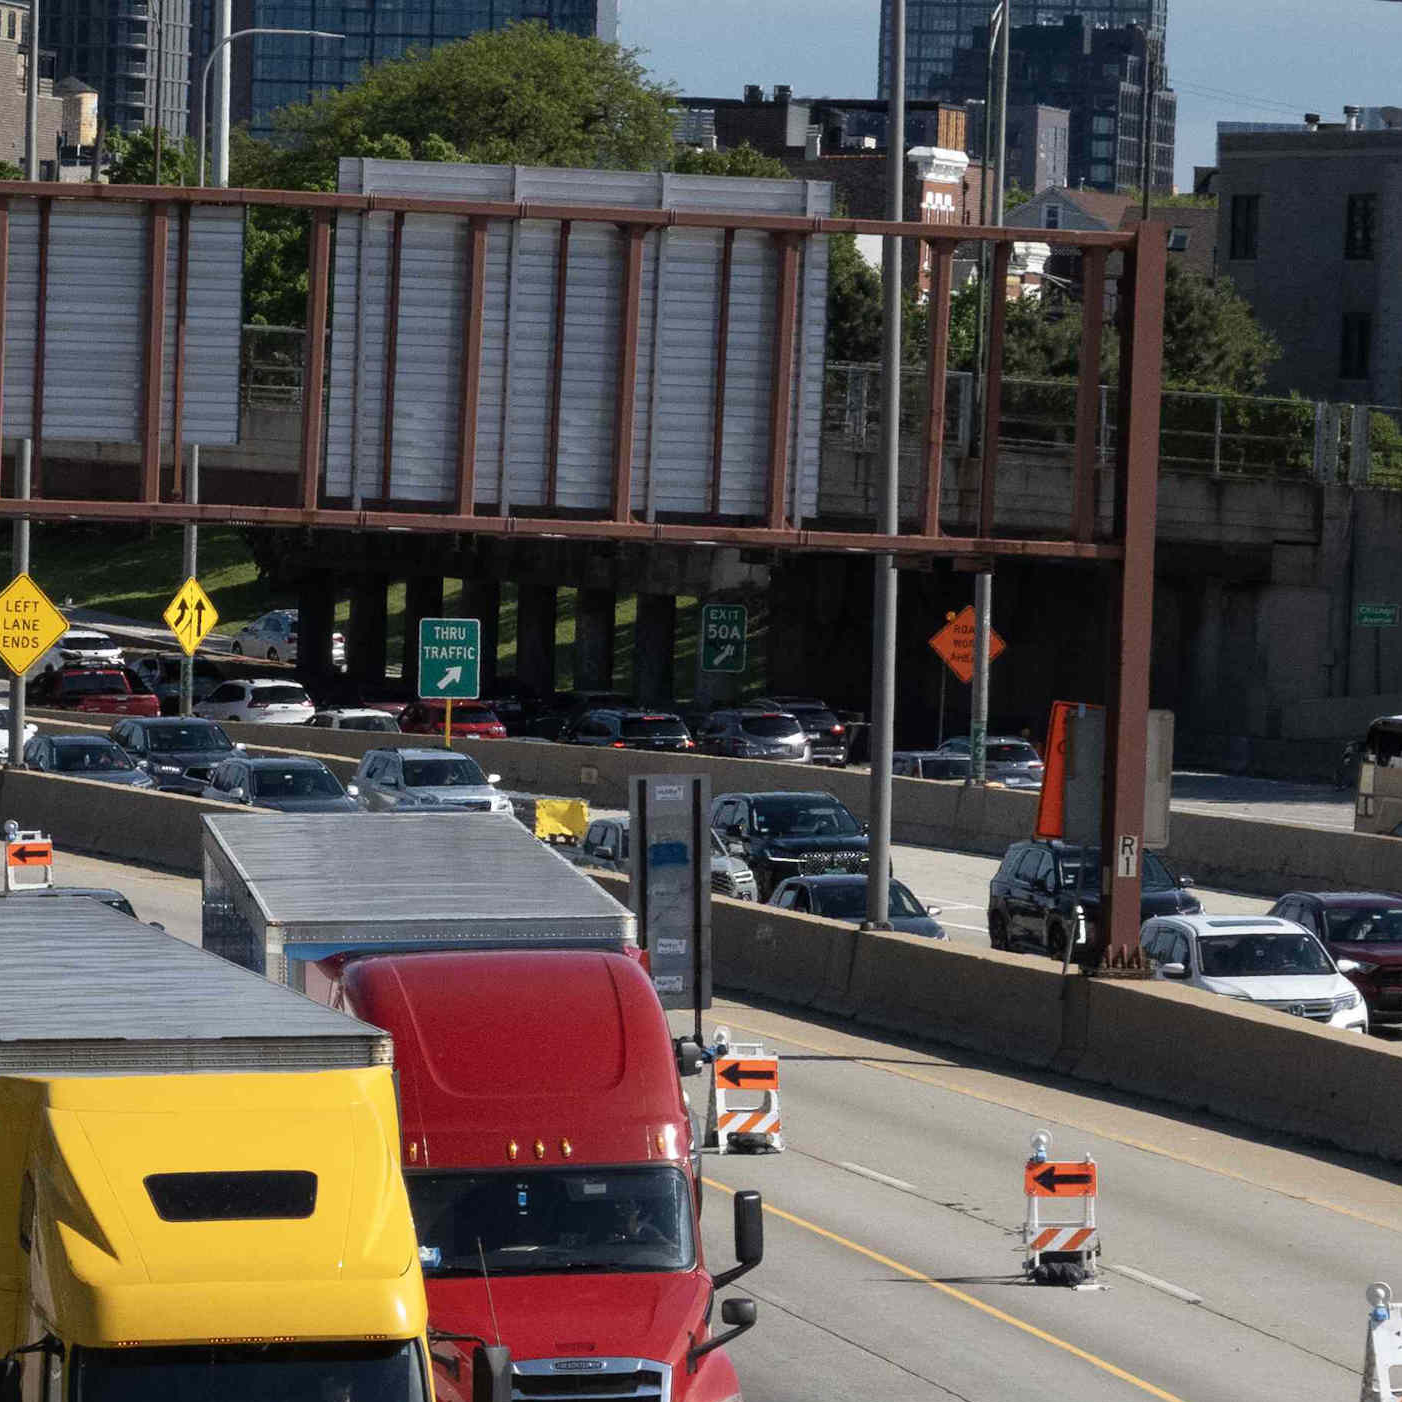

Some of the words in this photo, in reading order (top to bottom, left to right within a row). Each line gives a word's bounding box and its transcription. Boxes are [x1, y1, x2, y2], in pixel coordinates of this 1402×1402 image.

[6, 600, 40, 613] LEFT
[710, 608, 739, 620] EXIT
[3, 618, 40, 631] LANE
[434, 626, 466, 640] THRU
[708, 624, 741, 639] 50A
[2, 636, 40, 649] ENDS
[423, 646, 476, 660] TRAFFIC
